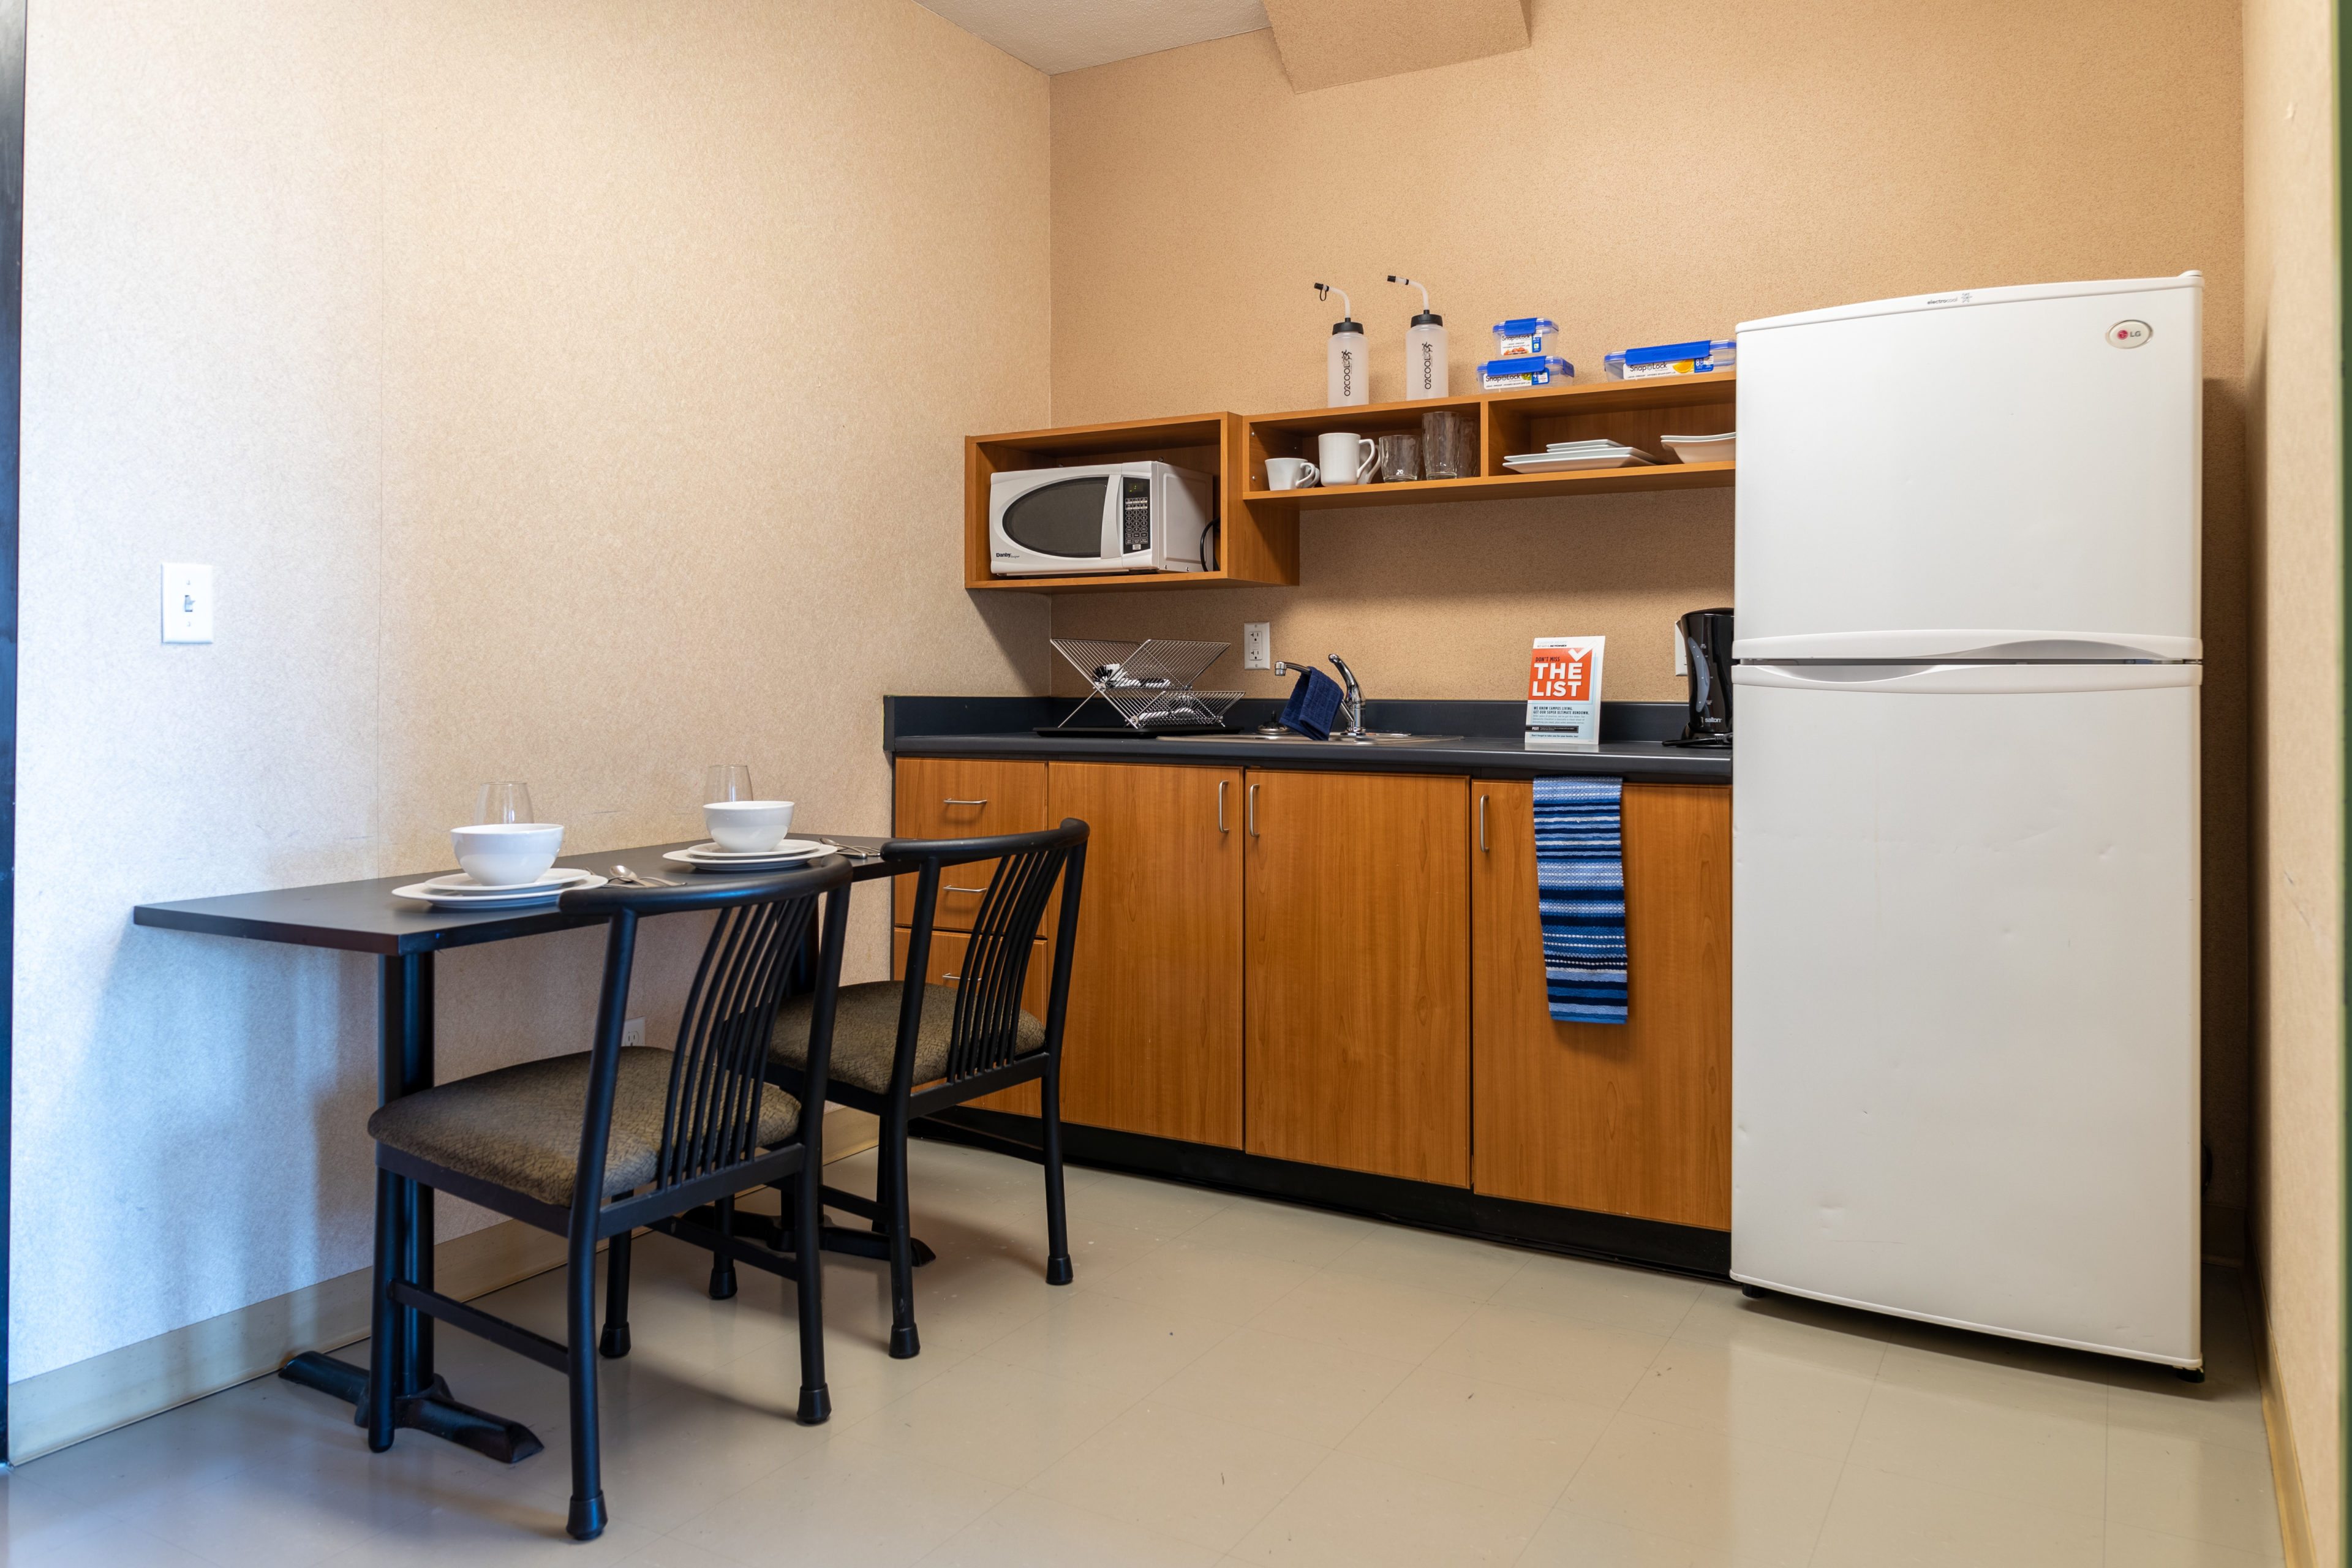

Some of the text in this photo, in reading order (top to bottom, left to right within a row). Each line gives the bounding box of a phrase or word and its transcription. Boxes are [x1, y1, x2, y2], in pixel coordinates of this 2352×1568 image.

[1653, 361, 1667, 370] Lock
[1534, 663, 1583, 679] THE
[1532, 681, 1581, 696] LIST
